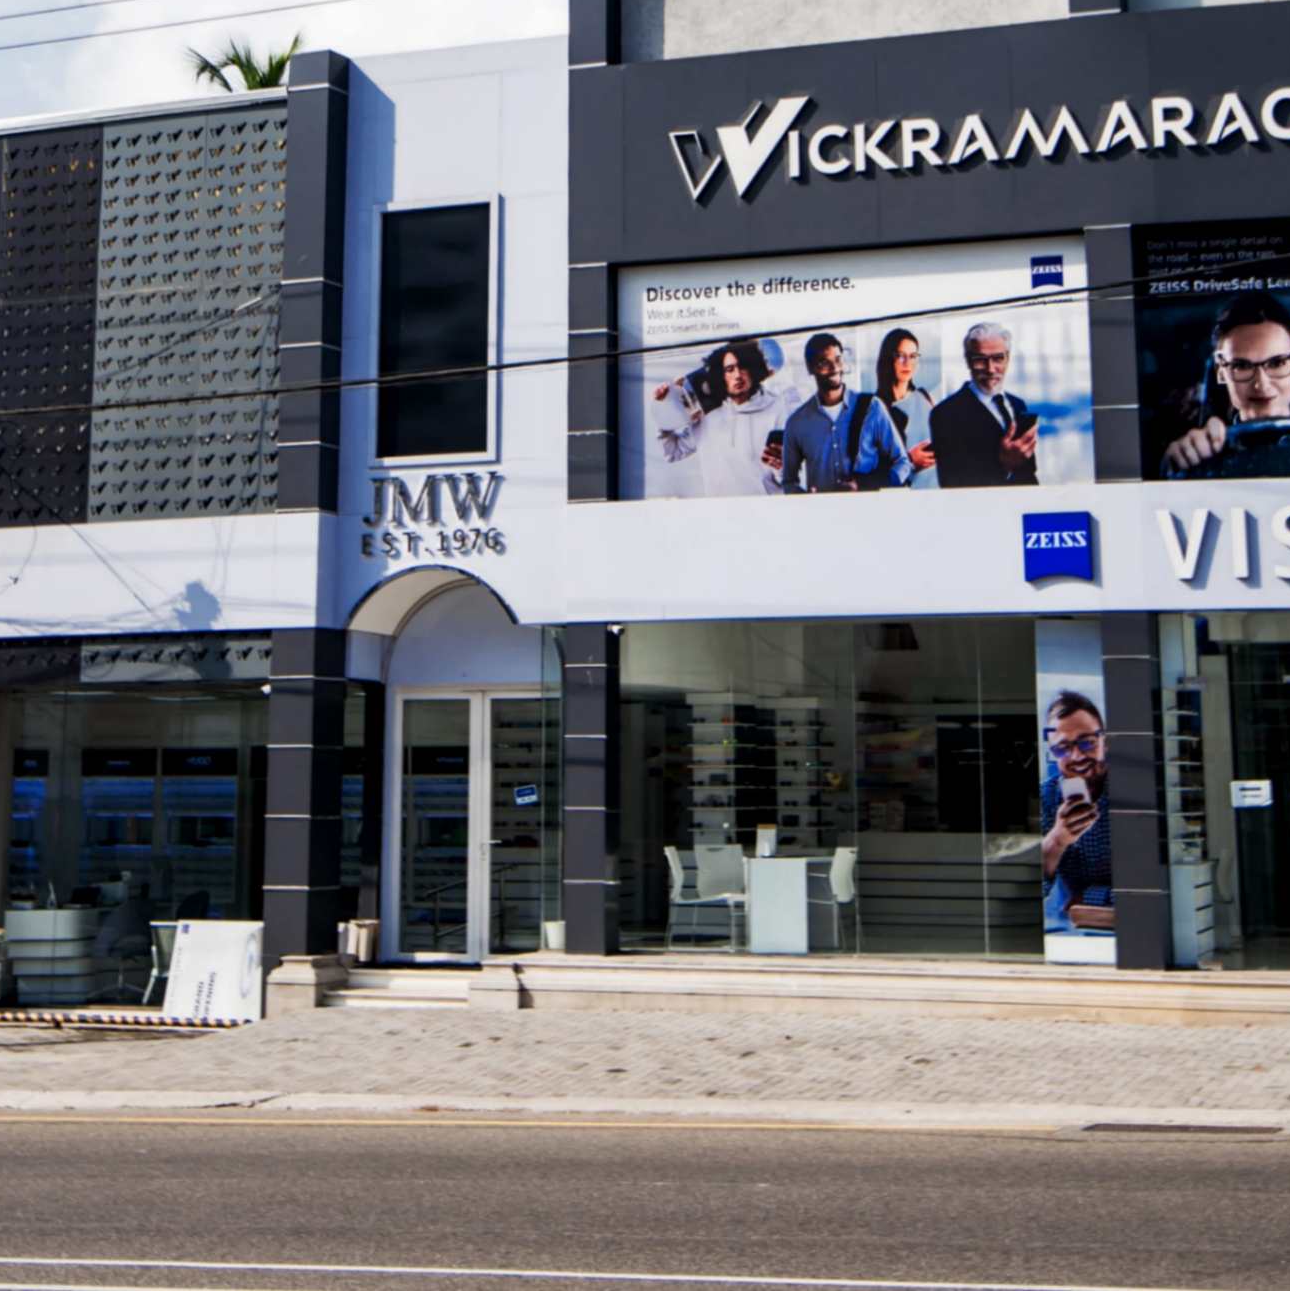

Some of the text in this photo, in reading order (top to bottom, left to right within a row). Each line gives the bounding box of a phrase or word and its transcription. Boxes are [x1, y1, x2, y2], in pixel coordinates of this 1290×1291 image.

[646, 275, 856, 303] Discover the difference.
[1149, 279, 1190, 294] ZEISS
[1193, 276, 1263, 292] DriveSafe
[363, 470, 502, 529] JMW
[1025, 529, 1088, 549] ZEISS
